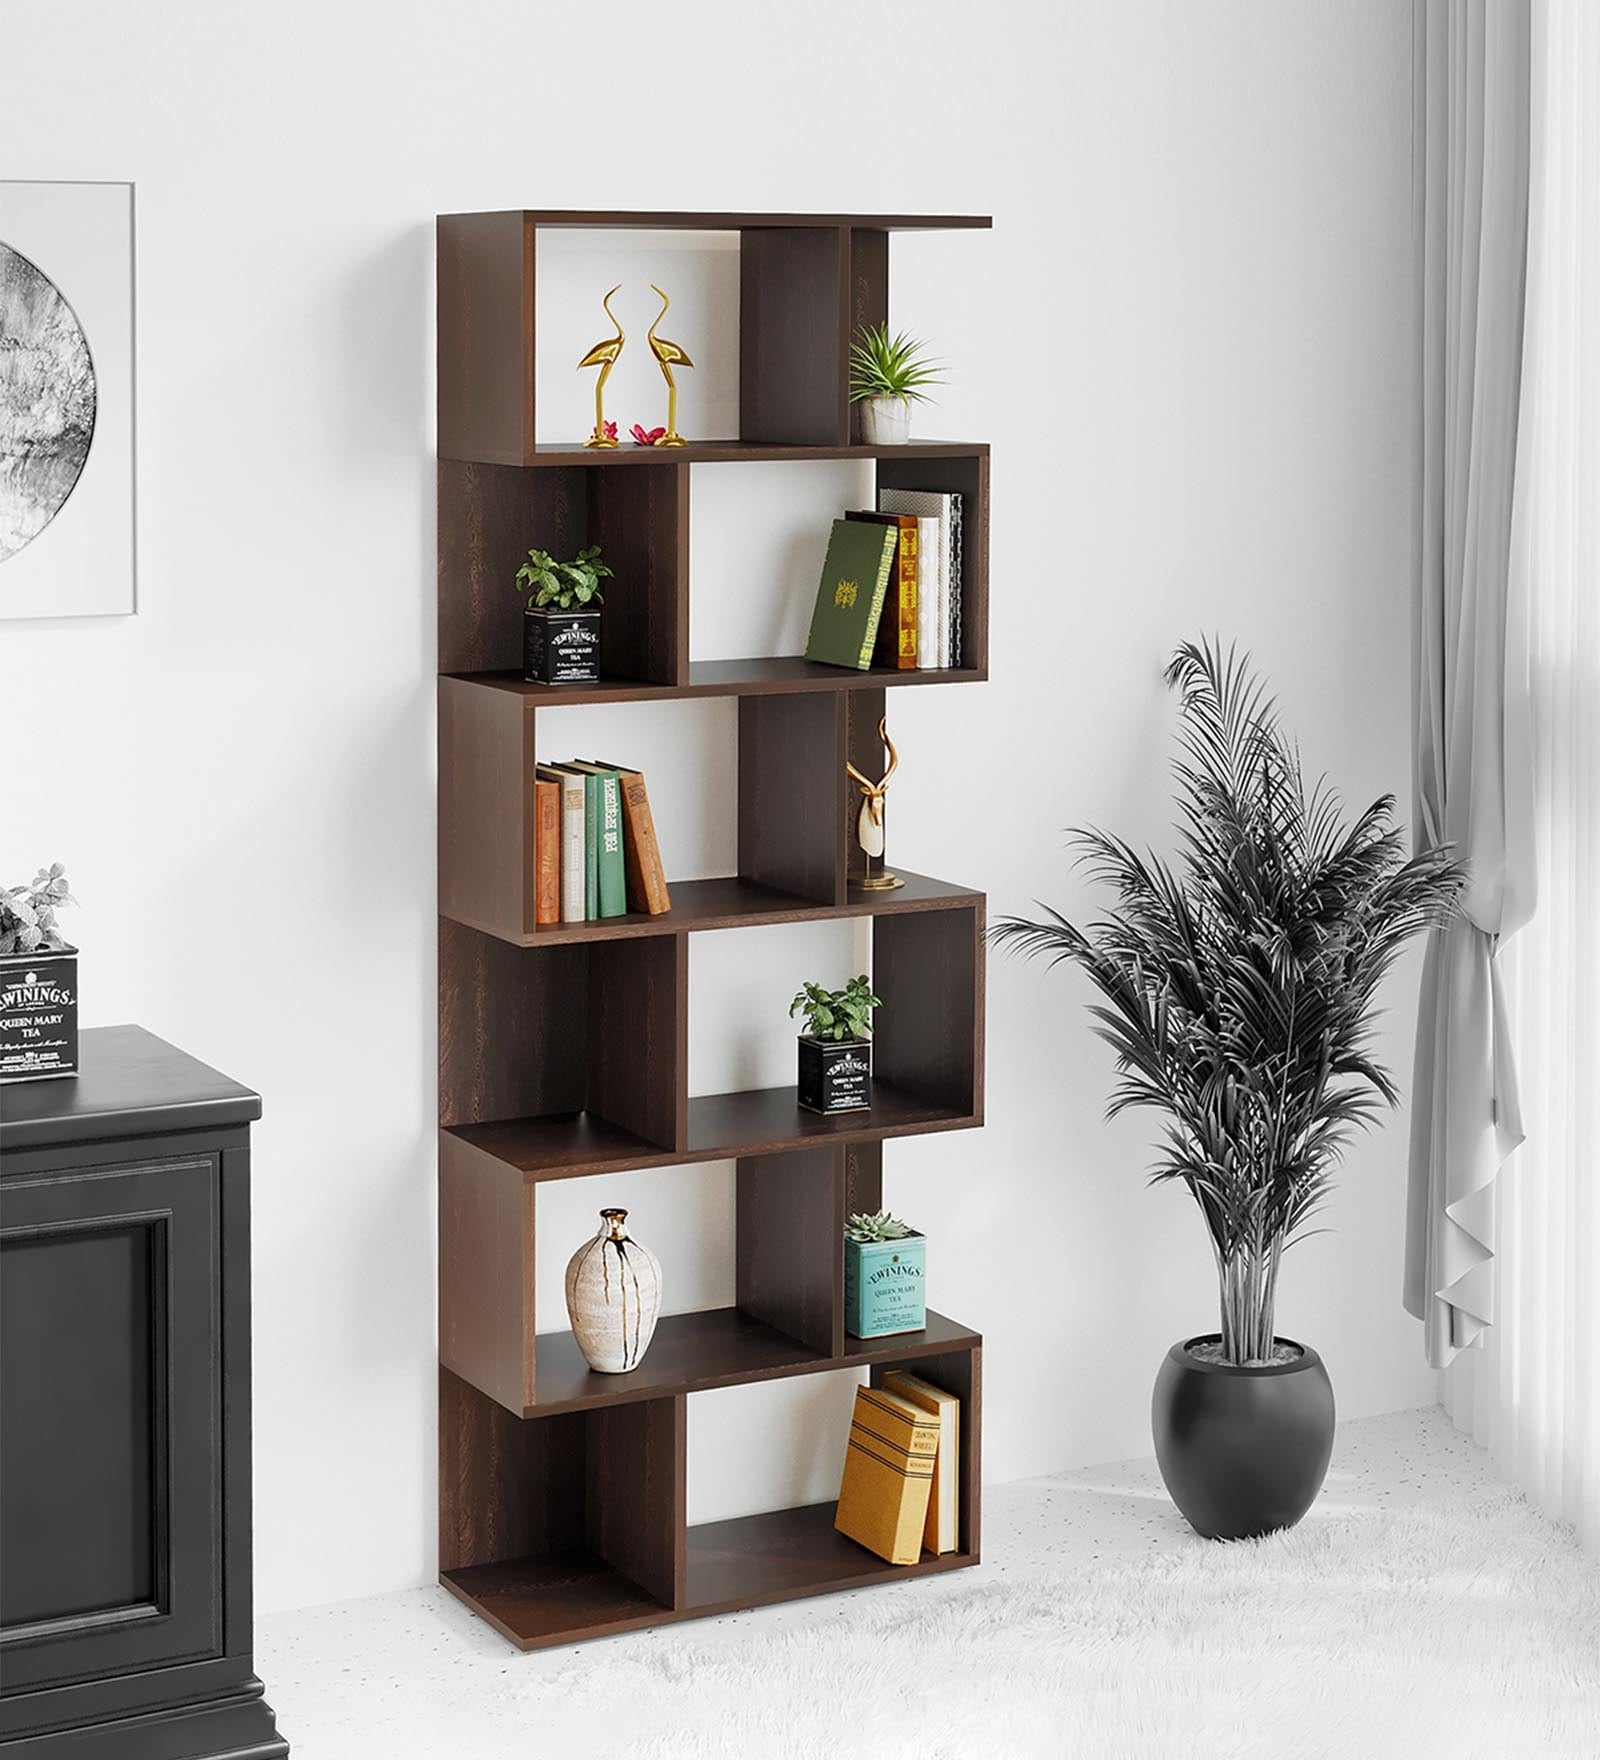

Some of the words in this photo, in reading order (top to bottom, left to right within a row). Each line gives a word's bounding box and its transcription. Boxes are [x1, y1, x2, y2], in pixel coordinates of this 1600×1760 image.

[0, 987, 70, 1011] WININGS
[0, 1017, 32, 1030] QUEEN
[34, 1015, 63, 1025] MARY
[22, 1028, 40, 1038] TEA
